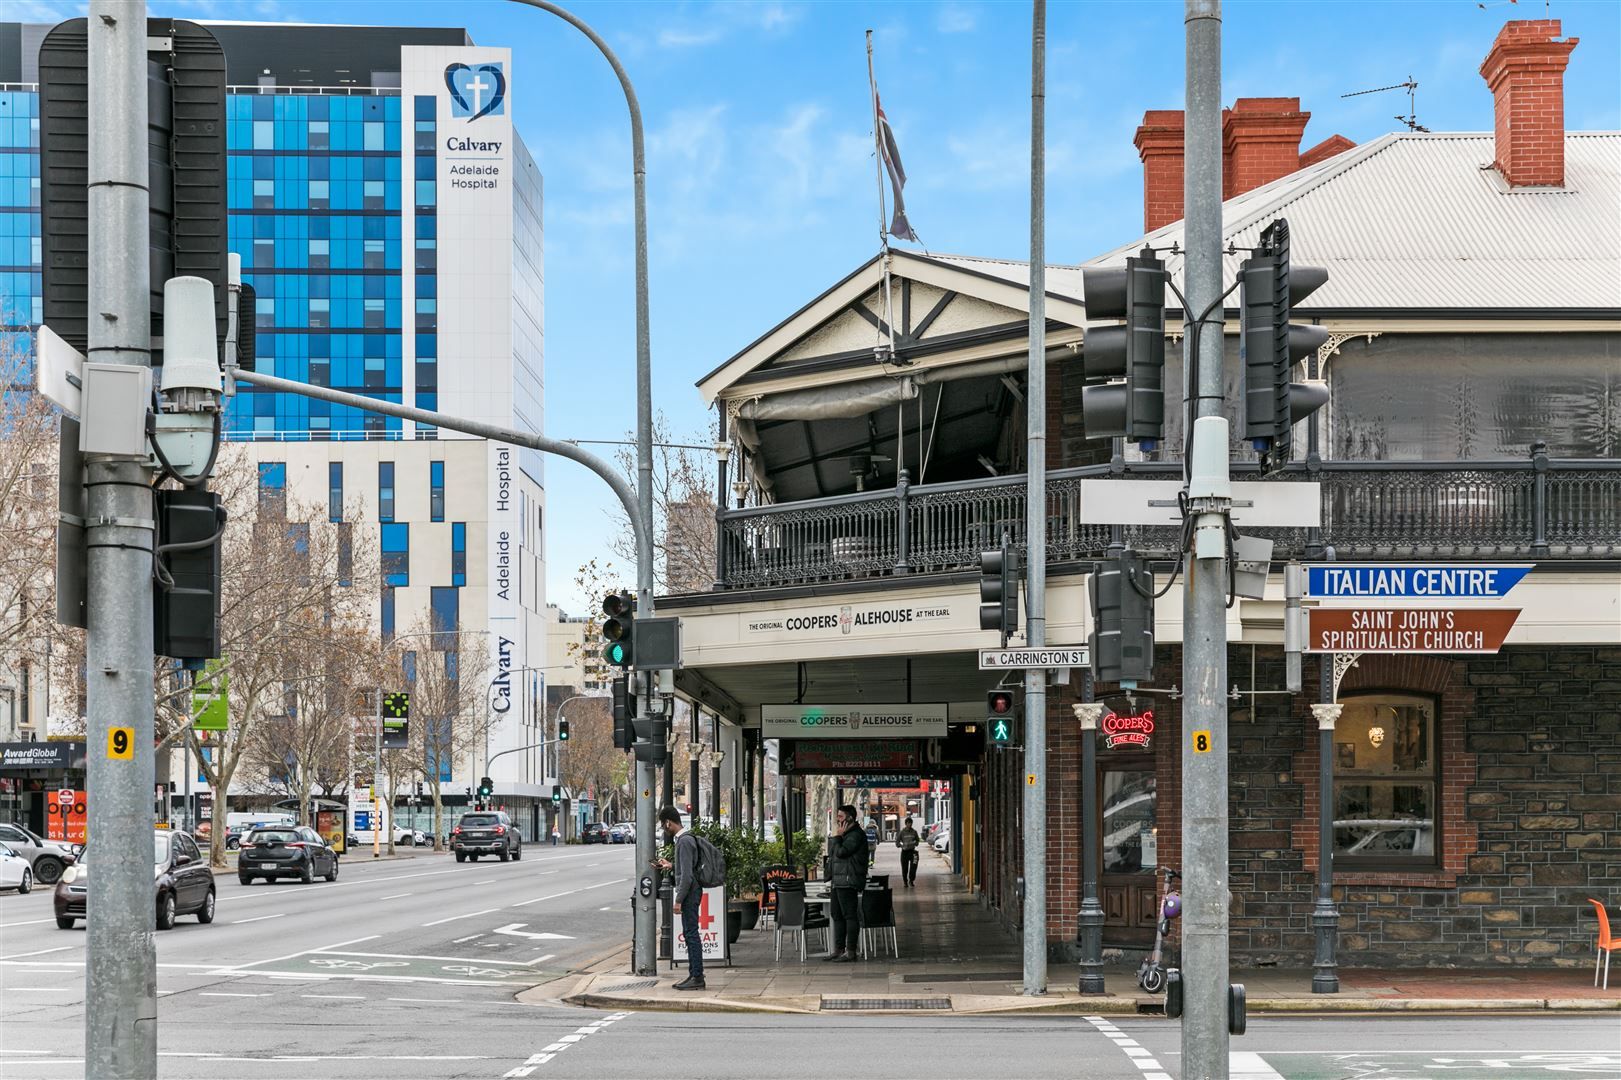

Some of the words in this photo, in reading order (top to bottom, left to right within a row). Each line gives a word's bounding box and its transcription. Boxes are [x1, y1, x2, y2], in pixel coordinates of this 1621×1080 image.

[446, 137, 502, 154] Calvary
[449, 165, 499, 175] Adelaide
[451, 179, 497, 189] Hospital
[496, 447, 512, 511] Hospital
[496, 530, 509, 600] Adelaide
[1324, 569, 1405, 595] ITALIAN
[1413, 569, 1498, 595] CENTRE
[759, 621, 783, 630] ORIGINAL
[786, 614, 838, 630] COOPERS
[854, 608, 913, 626] ALEHOUSE
[936, 609, 950, 617] EARL
[1352, 611, 1394, 629] SAINT
[1399, 611, 1454, 629] JOHN'S
[1321, 631, 1418, 649] SPIRITUALIST
[1424, 631, 1483, 649] CHURCH
[1000, 652, 1068, 664] CARRINGTON
[1071, 651, 1085, 663] ST
[491, 635, 515, 714] Calvary
[800, 716, 848, 726] COOPERS
[862, 716, 913, 725] ALEHOUSE
[1103, 710, 1154, 735] COOPERS
[113, 729, 128, 754] 9
[1113, 735, 1128, 743] FINE
[1129, 733, 1144, 742] ALES
[1197, 734, 1207, 751] 8
[4, 748, 58, 757] AwardGlobal
